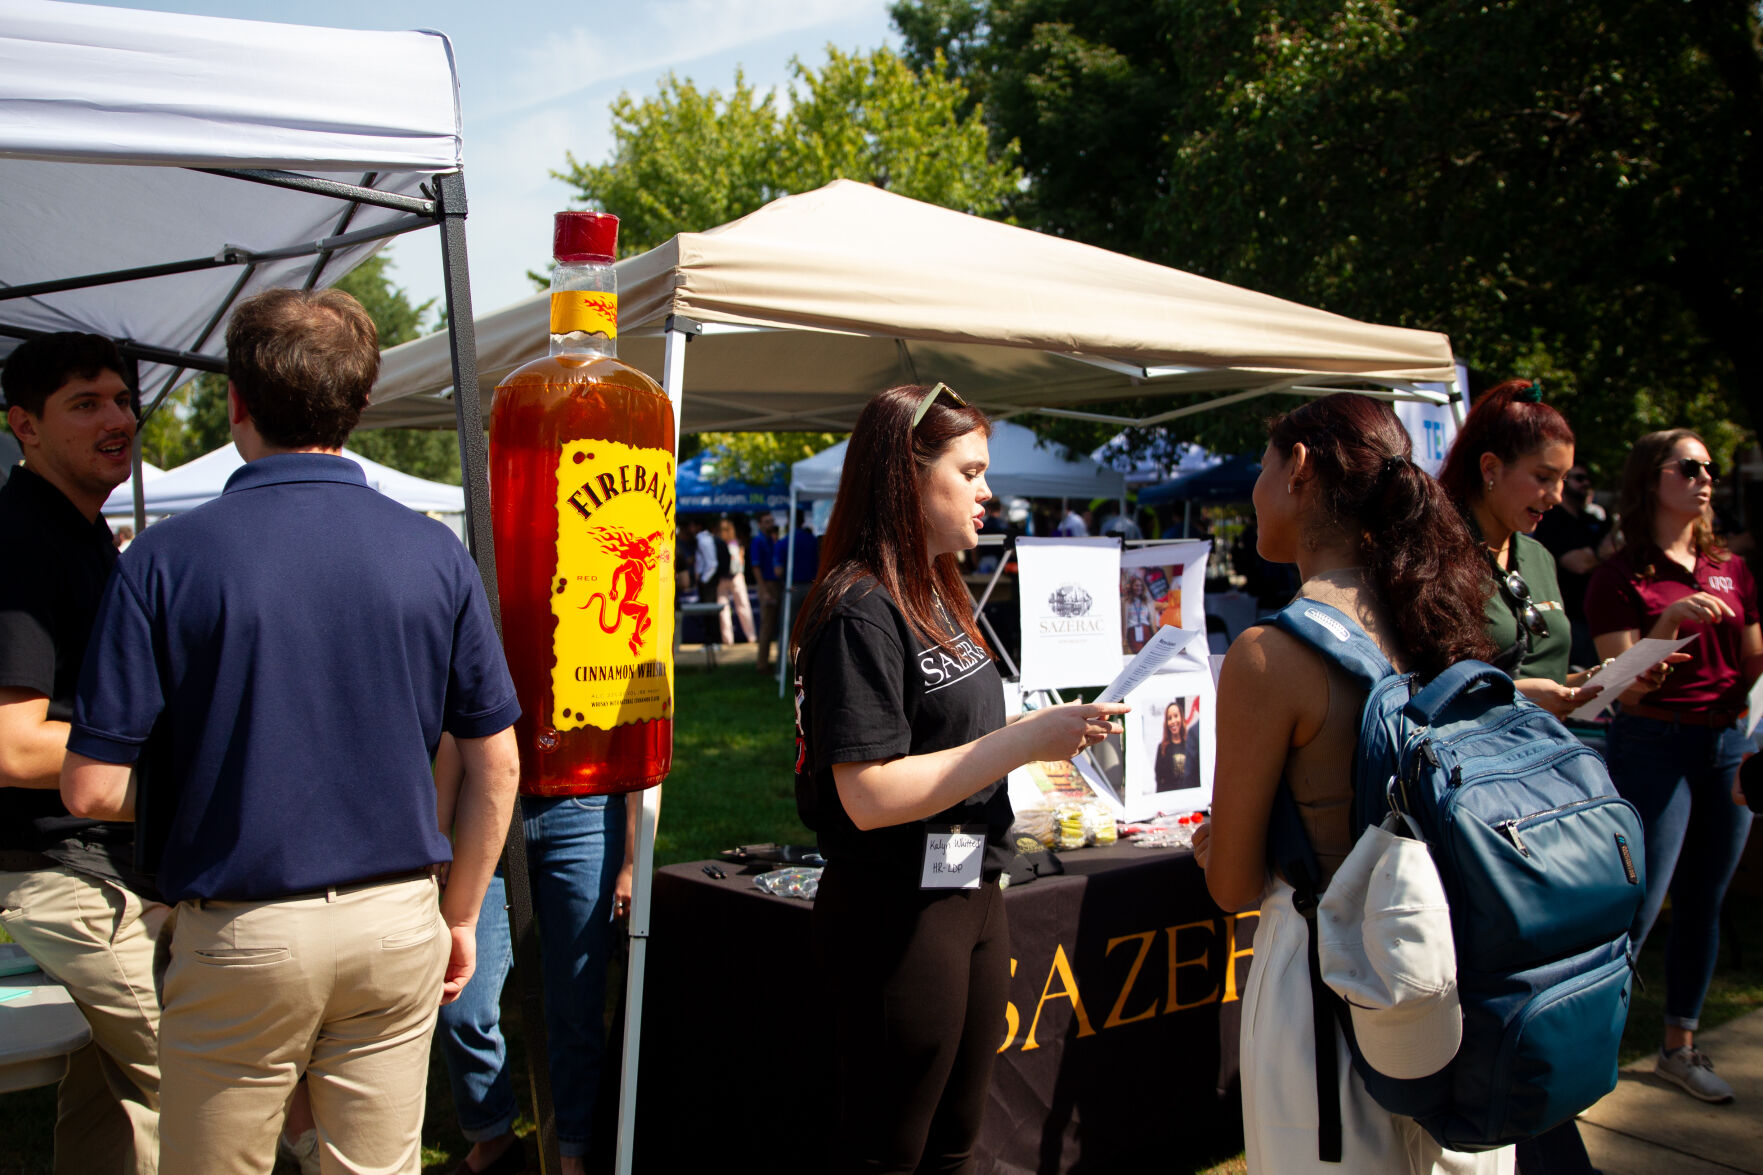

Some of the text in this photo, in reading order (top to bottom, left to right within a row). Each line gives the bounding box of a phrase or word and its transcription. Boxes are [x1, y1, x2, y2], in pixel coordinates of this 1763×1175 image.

[566, 464, 674, 524] FIREBALL
[1039, 619, 1104, 633] SAZERAC
[575, 663, 635, 682] CINNAMON
